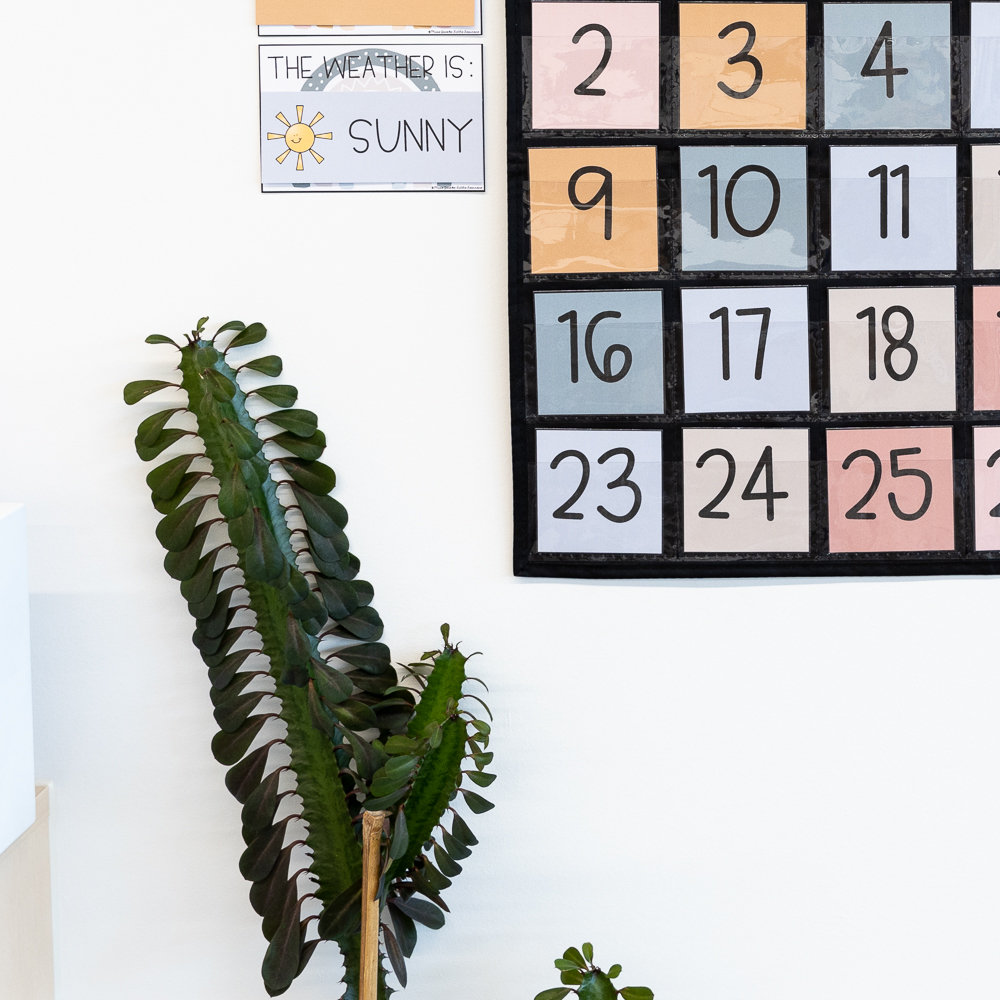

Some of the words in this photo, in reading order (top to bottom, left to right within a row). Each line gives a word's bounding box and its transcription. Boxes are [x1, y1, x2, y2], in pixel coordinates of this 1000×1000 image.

[268, 56, 313, 79] THE
[324, 55, 434, 78] WEATHER
[445, 55, 472, 78] IS:
[572, 24, 612, 96] 2
[718, 21, 762, 99] 3
[861, 21, 908, 98] 4
[349, 118, 472, 153] SUNNY
[568, 166, 612, 240] 9
[698, 165, 780, 239] 10
[868, 165, 909, 239] 11
[558, 310, 632, 383] 16
[710, 307, 771, 380] 17
[856, 306, 918, 381] 18
[550, 447, 641, 523] 23
[696, 446, 788, 521] 24
[842, 447, 932, 521] 25
